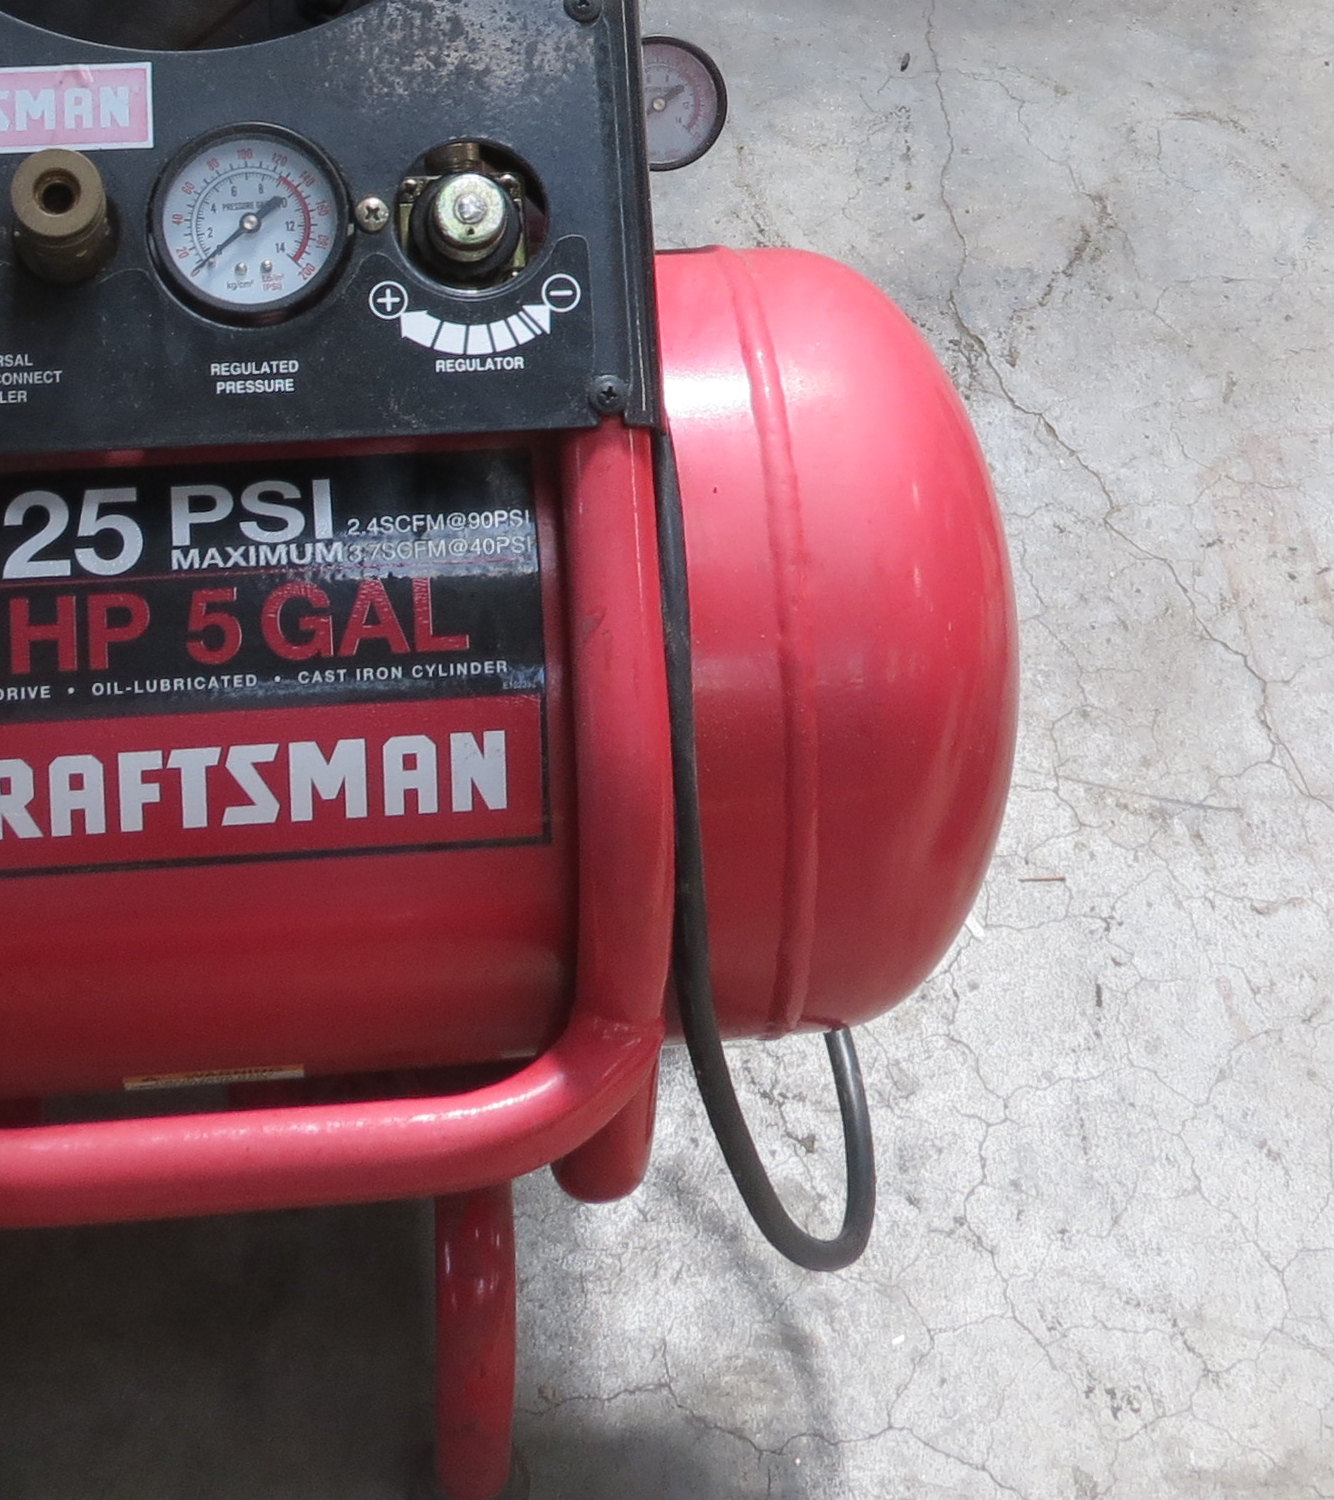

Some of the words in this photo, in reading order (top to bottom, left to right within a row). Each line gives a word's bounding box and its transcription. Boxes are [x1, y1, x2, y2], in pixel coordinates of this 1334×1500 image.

[237, 148, 252, 159] 100
[272, 152, 288, 166] 120
[182, 182, 195, 195] 60
[231, 186, 237, 197] 6
[258, 184, 264, 194] 8
[211, 203, 217, 214] 4
[222, 202, 254, 211] PRESSURE
[172, 214, 183, 225] 40
[207, 227, 213, 237] 2
[286, 221, 295, 232] 12
[176, 247, 189, 260] 20
[275, 243, 285, 253] 14
[298, 263, 316, 281] 200
[210, 360, 299, 377] REGULATED
[434, 356, 525, 373] REGULATOR
[215, 377, 295, 394] PRESSURE
[170, 479, 334, 546] PSI
[347, 508, 531, 535] 2.4SCFM@90PSI
[171, 541, 344, 571] MAXIMUM
[186, 587, 242, 665] 5
[261, 576, 470, 660] GAL
[92, 673, 257, 697] OIL-LUBRICATED
[298, 667, 347, 685] CAST
[355, 666, 403, 682] IRON
[411, 660, 507, 680] CYLINDER
